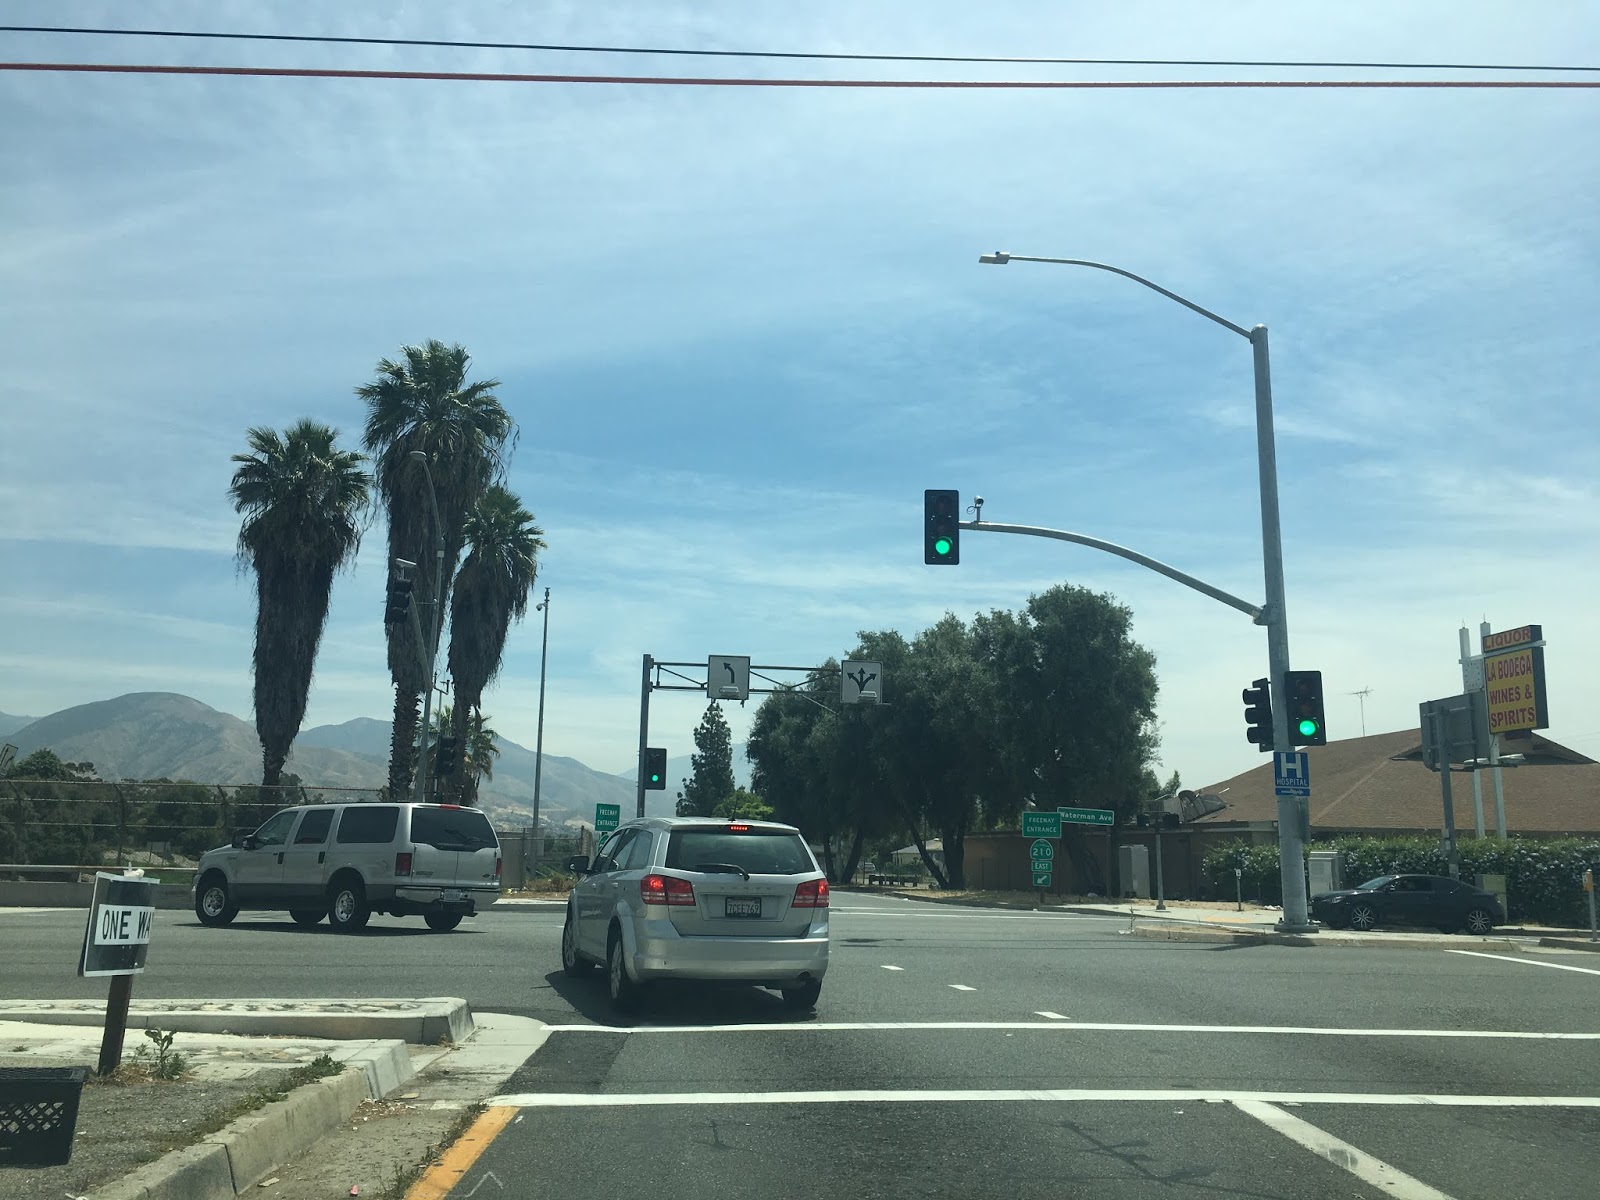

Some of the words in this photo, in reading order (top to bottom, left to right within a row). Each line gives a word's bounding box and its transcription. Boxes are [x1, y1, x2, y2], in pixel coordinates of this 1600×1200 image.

[1485, 627, 1531, 649] LIQUOR
[1486, 662, 1496, 682] LA
[1498, 654, 1532, 679] BODEGA
[1489, 686, 1521, 705] WINES
[1524, 683, 1532, 700] &
[1490, 706, 1535, 727] SPIRITS
[1280, 752, 1303, 778] H
[1276, 778, 1308, 786] HOSPITAL
[597, 819, 618, 827] ENTRANCE
[1060, 811, 1096, 820] Waterman
[1032, 847, 1052, 856] 210
[102, 909, 132, 940] ONE
[137, 911, 154, 939] WA
